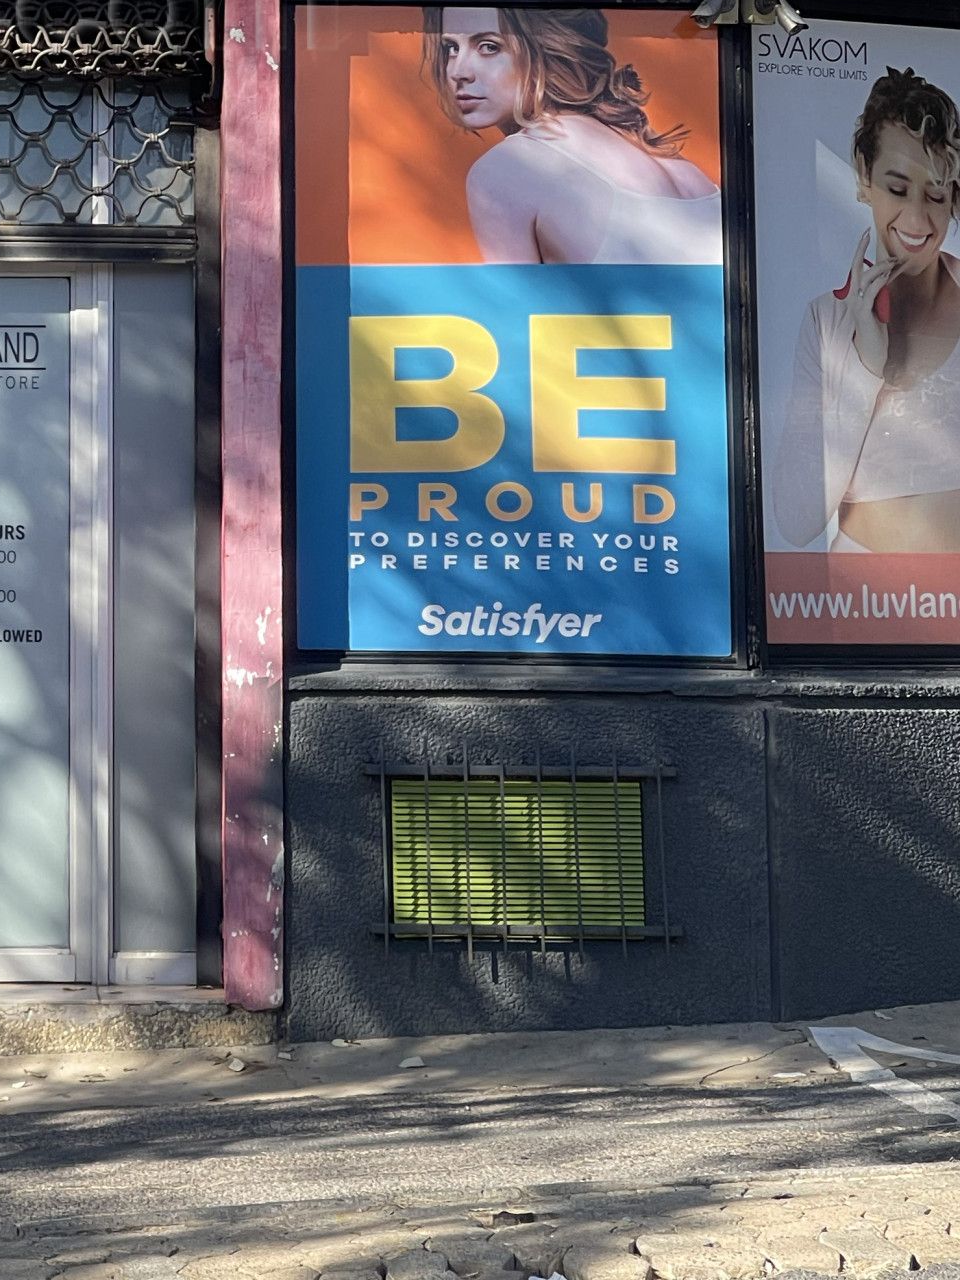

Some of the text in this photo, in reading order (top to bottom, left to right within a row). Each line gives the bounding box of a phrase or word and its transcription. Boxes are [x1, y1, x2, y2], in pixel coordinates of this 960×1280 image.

[758, 34, 868, 65] SVAKOM
[758, 62, 868, 81] EXPLORE YOUR LIMITS
[349, 314, 677, 475] BE
[349, 481, 677, 524] PROUD
[350, 532, 679, 552] TO DISCOVER YOUR
[349, 554, 680, 575] PREFERENCES
[769, 583, 960, 619] www.luvlan
[417, 601, 603, 643] Satisfyer
